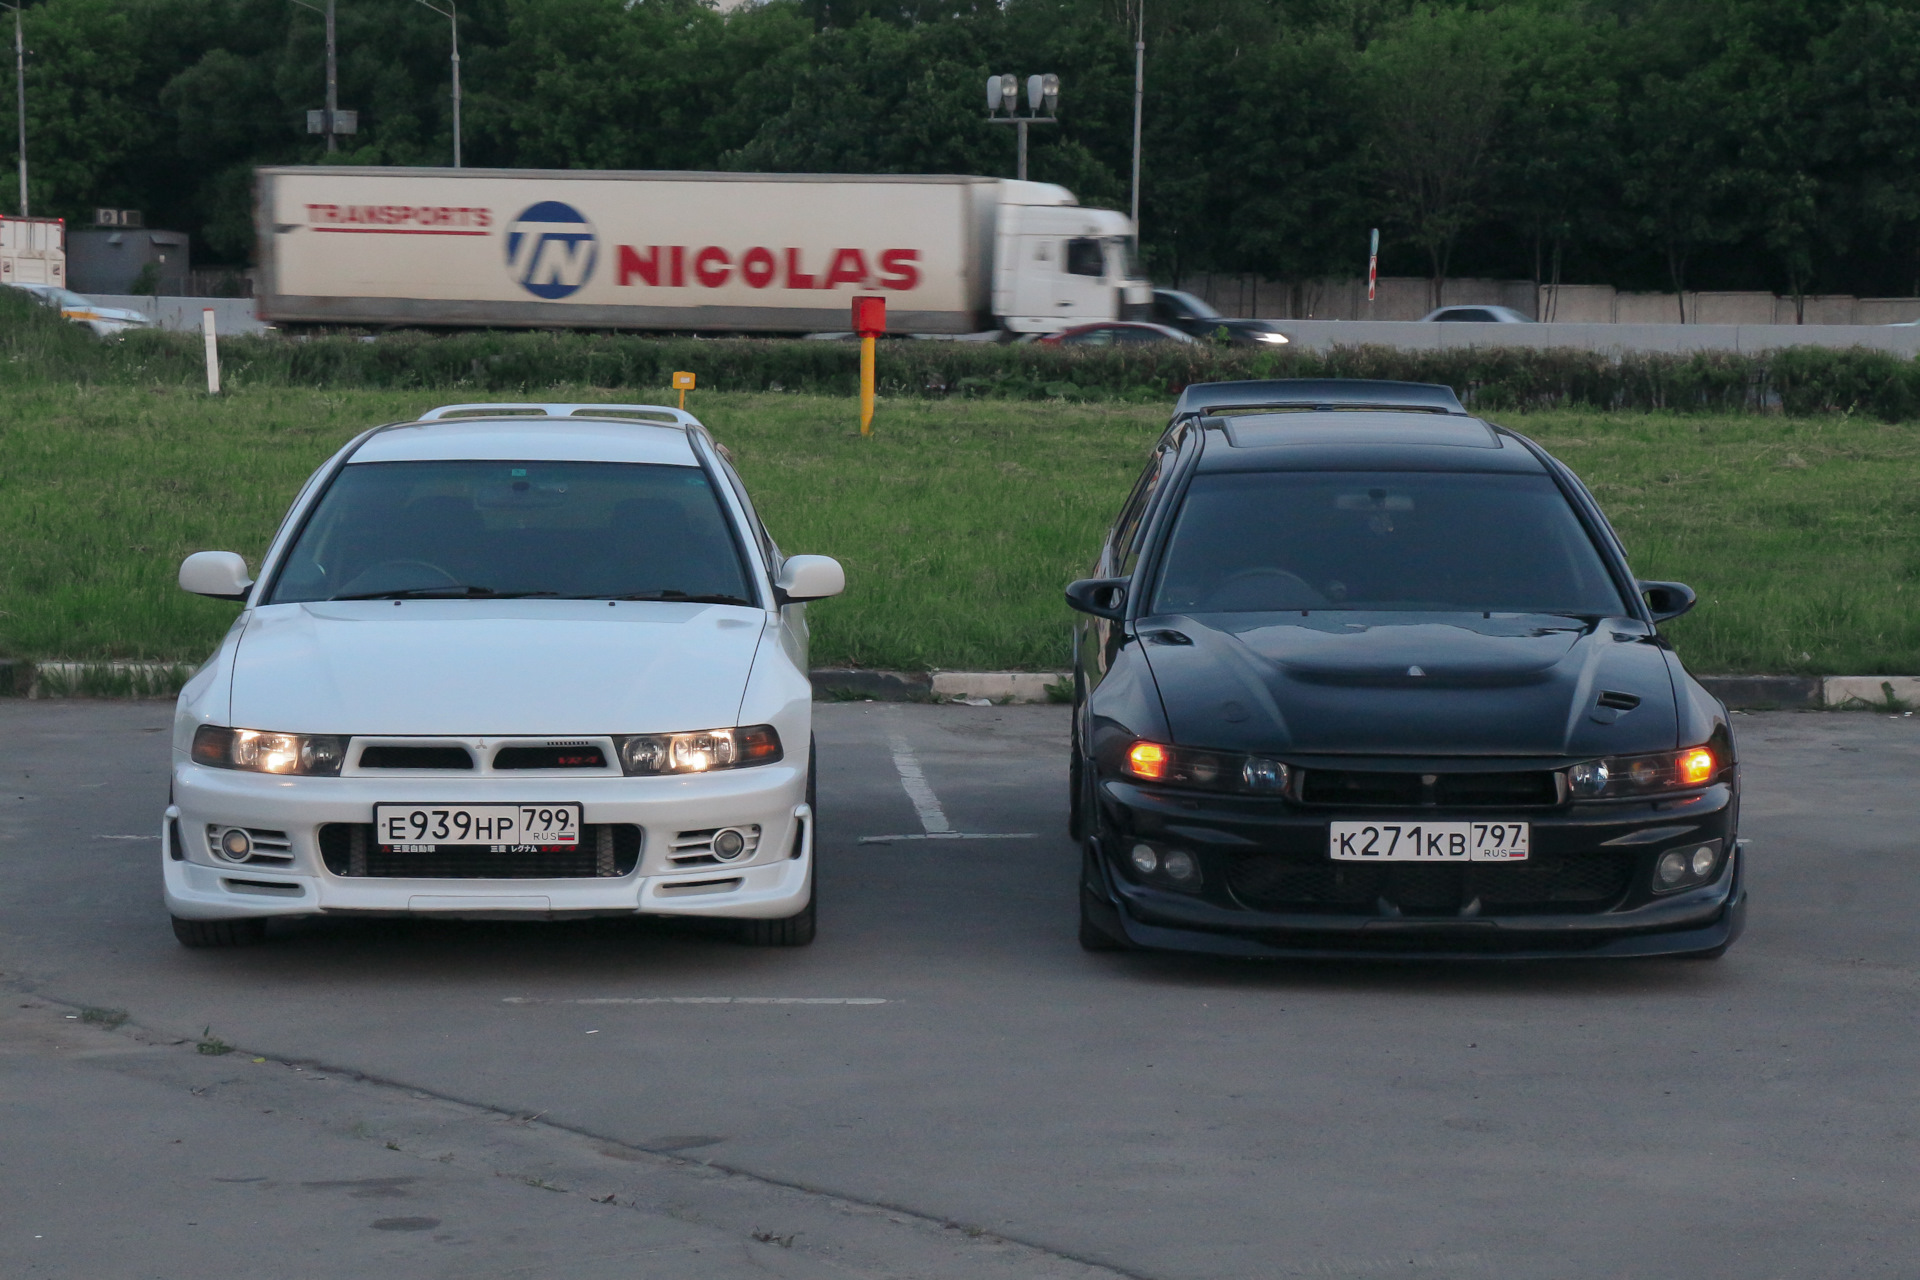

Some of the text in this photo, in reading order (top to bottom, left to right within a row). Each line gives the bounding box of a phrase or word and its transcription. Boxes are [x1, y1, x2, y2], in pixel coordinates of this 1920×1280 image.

[304, 203, 493, 228] TRANSPORTS
[615, 244, 921, 292] NICOLAS
[522, 808, 569, 831] 799
[533, 832, 556, 841] RUS
[1474, 824, 1523, 848] 797
[1484, 849, 1508, 858] RUS
